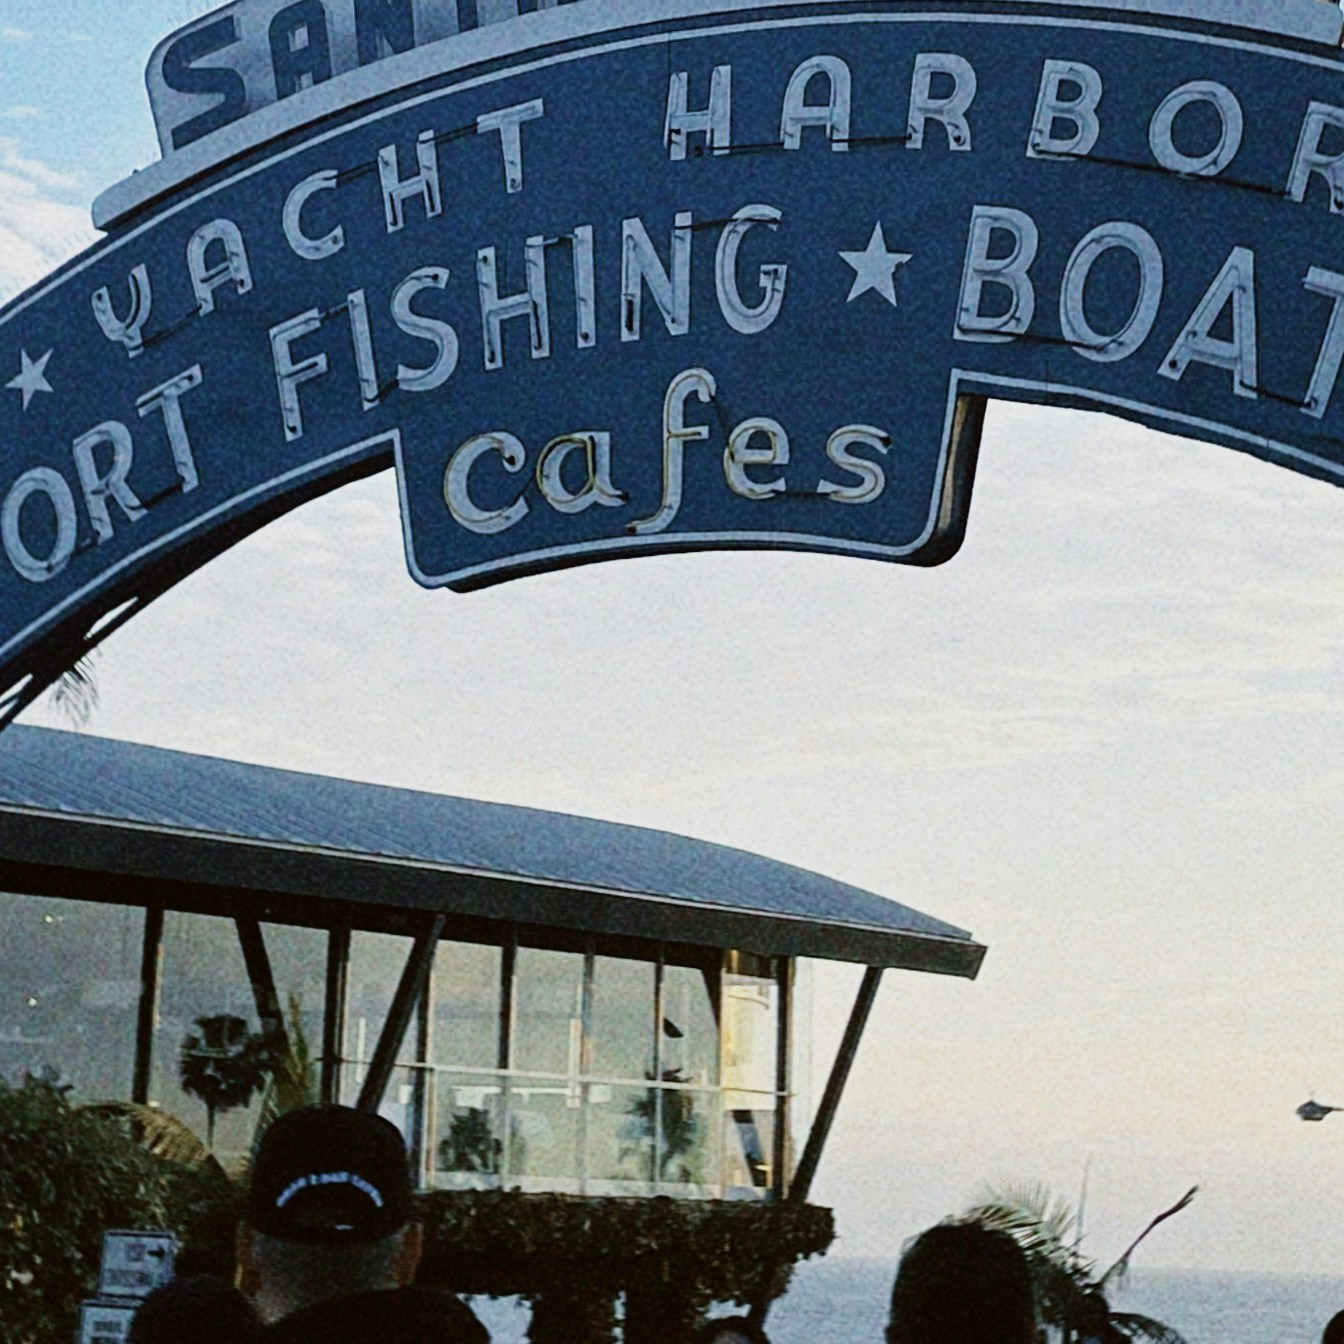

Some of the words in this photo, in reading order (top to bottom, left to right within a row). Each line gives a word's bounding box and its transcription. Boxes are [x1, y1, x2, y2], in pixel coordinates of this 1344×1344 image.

[91, 98, 544, 358] YACHT
[268, 203, 788, 442] FISHING
[442, 367, 892, 536] cafes
